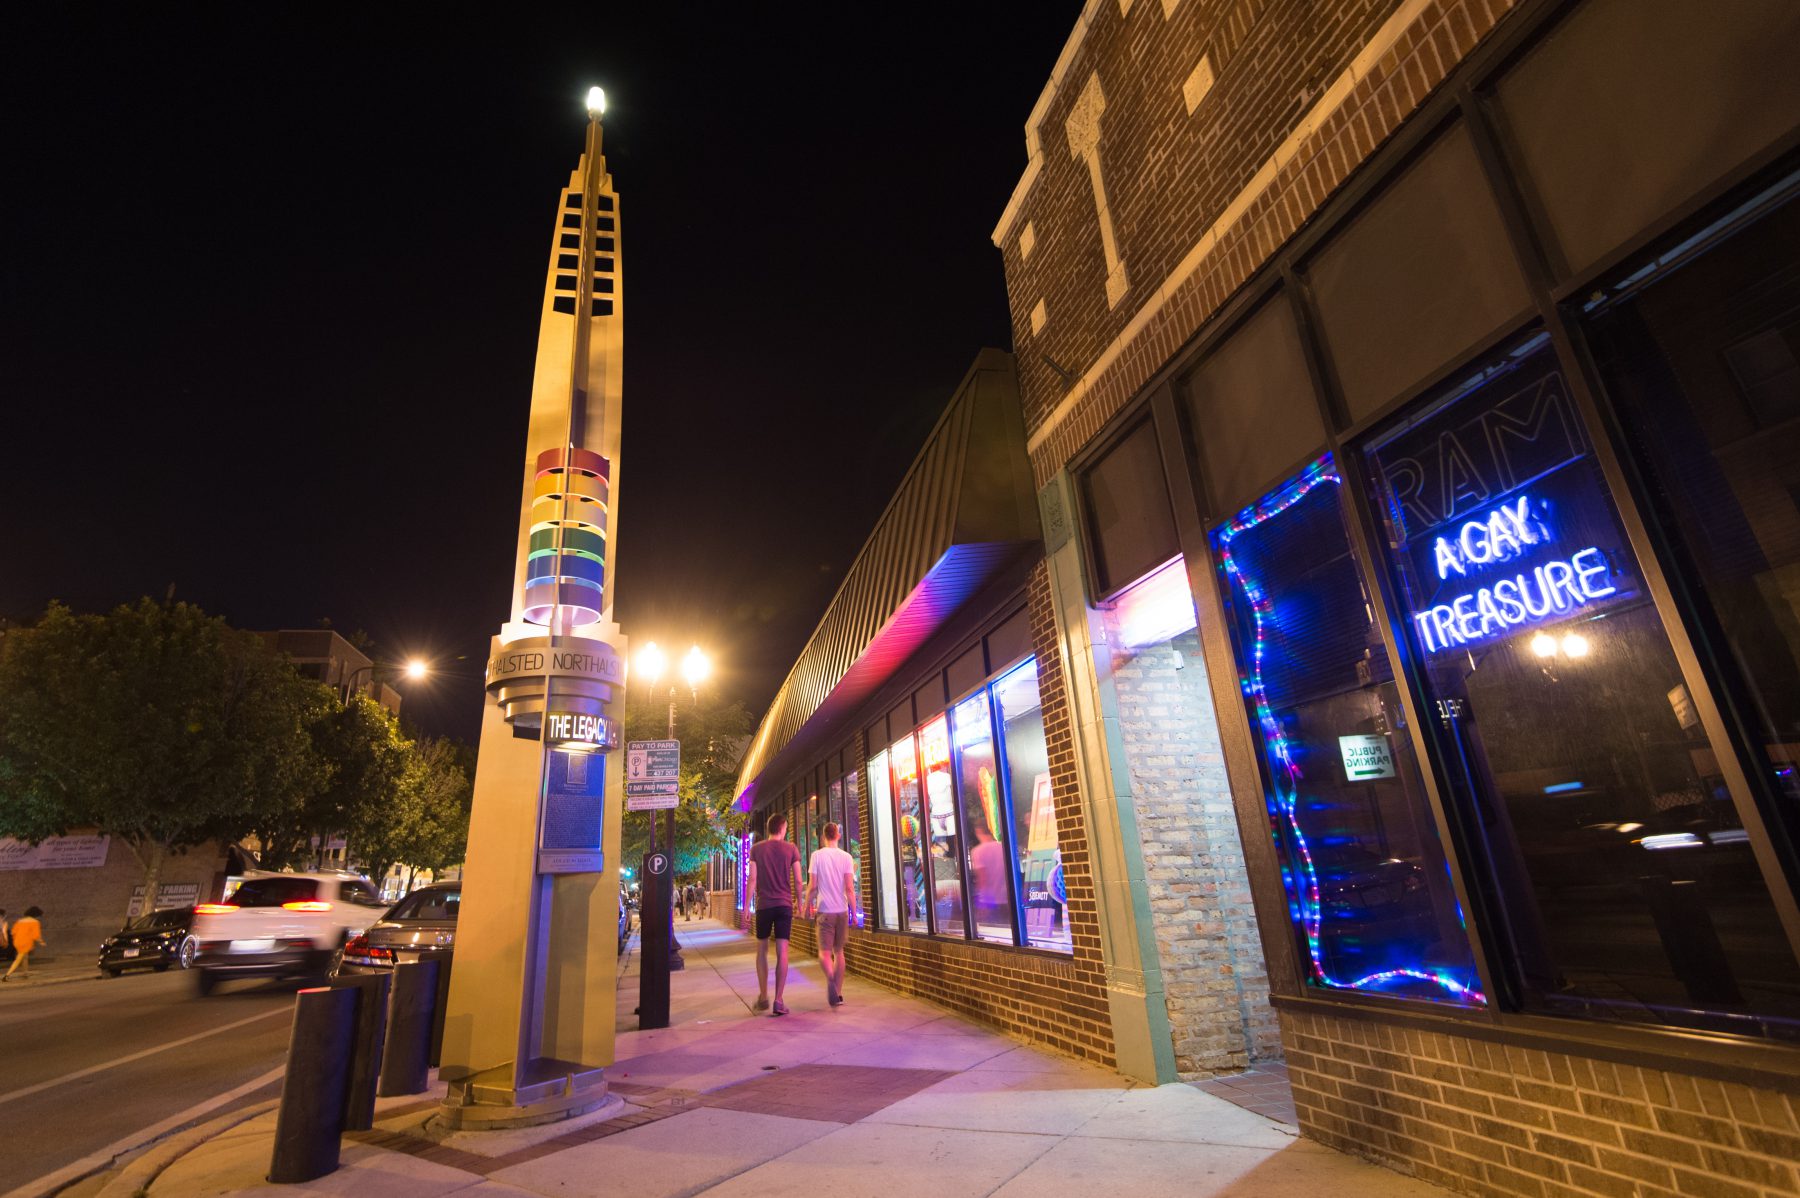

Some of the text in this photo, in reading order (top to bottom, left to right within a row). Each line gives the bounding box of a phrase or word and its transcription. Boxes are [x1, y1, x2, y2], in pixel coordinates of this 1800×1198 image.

[1384, 372, 1587, 542] RAM
[1433, 495, 1533, 580] A GAY
[1415, 547, 1616, 652] TREASURE
[549, 714, 571, 739] THE
[572, 715, 608, 742] LEGACY
[163, 884, 198, 895] PARKING
